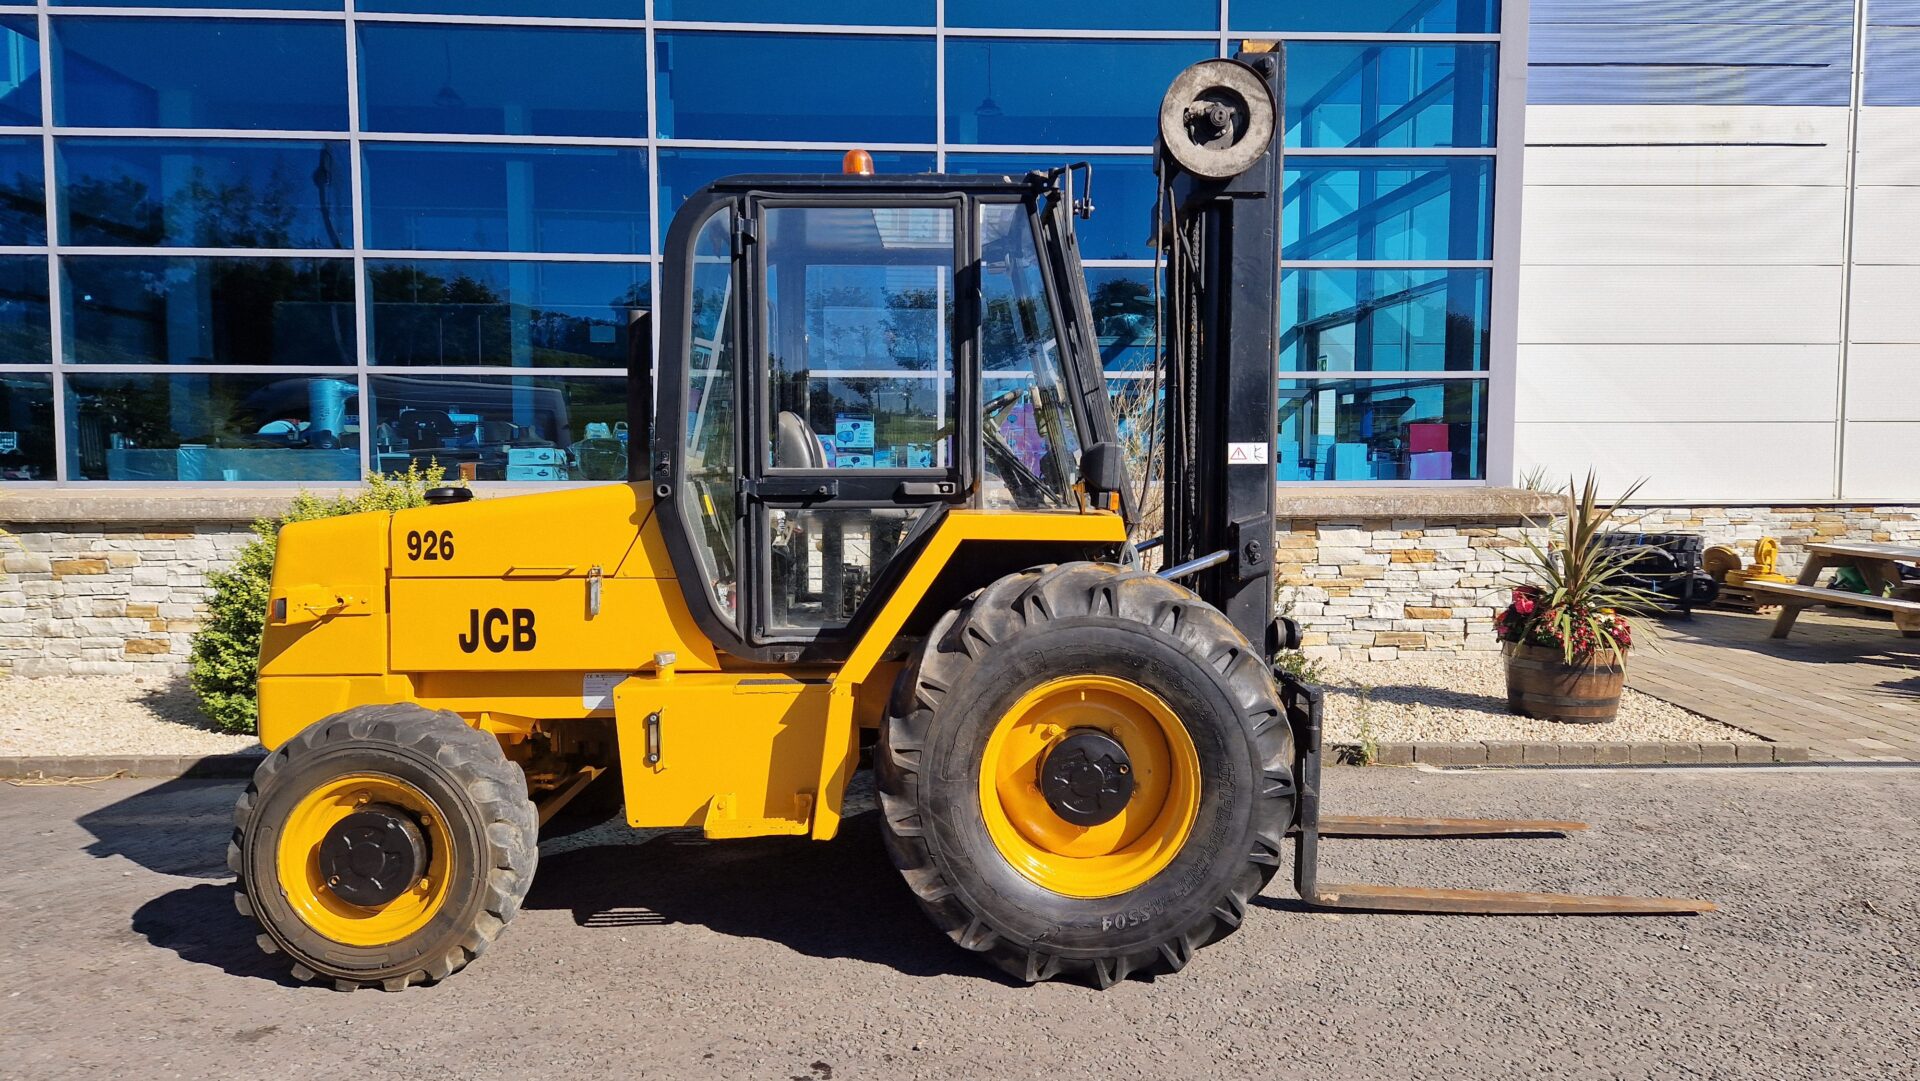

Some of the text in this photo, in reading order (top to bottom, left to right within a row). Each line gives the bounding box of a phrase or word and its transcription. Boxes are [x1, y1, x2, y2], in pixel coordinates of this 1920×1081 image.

[406, 530, 455, 561] 926
[458, 607, 537, 654] JCB
[1101, 897, 1166, 932] AS504
